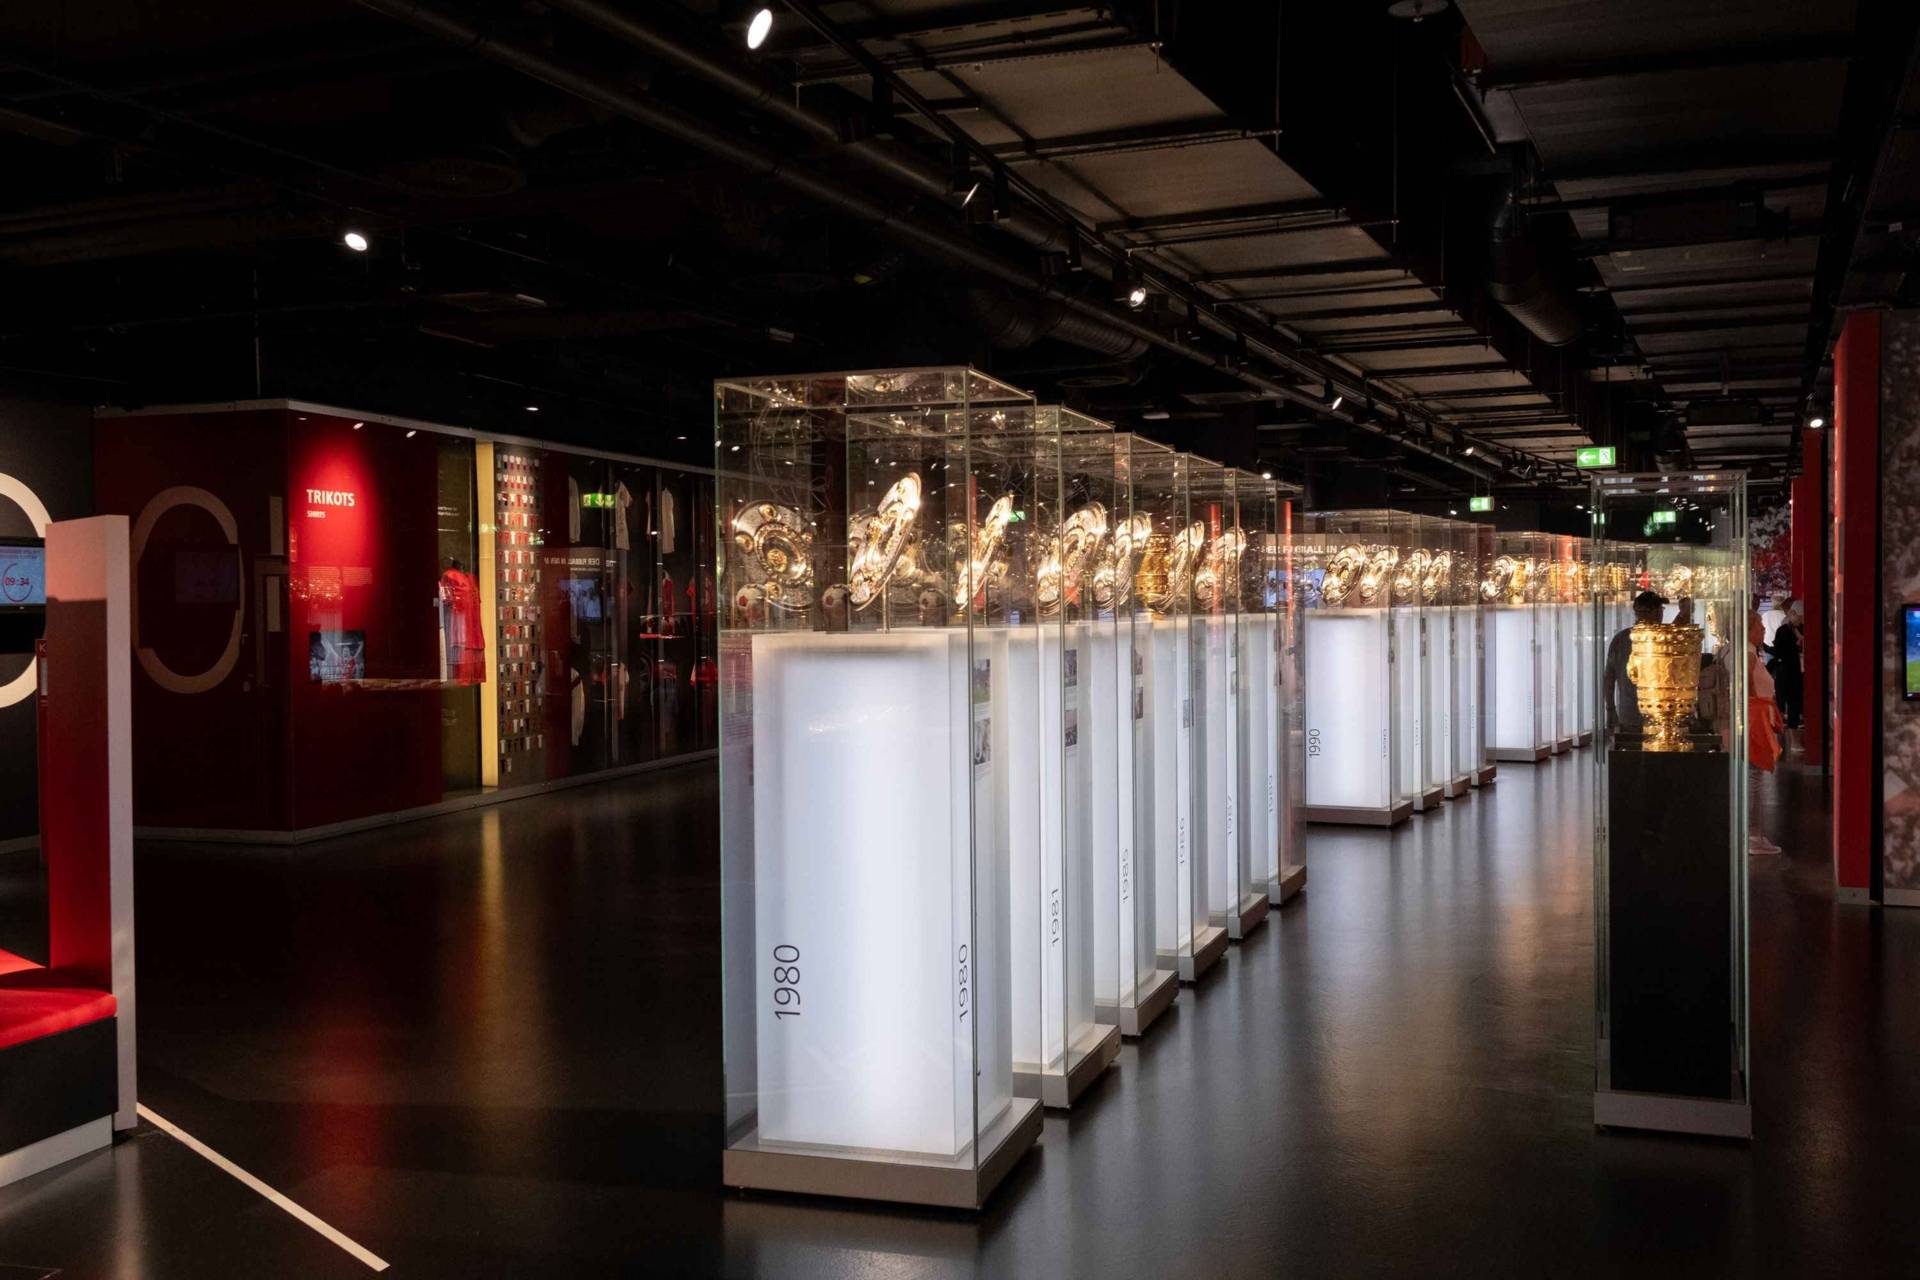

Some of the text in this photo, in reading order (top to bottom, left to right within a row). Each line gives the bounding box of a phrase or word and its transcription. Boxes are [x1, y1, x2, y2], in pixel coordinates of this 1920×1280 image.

[306, 489, 355, 507] TRIKOTS
[1308, 728, 1321, 758] 1990
[1121, 847, 1129, 903] 1985
[1051, 888, 1060, 947] 1981
[773, 944, 801, 1020] 1980
[958, 944, 969, 1023] 1980
